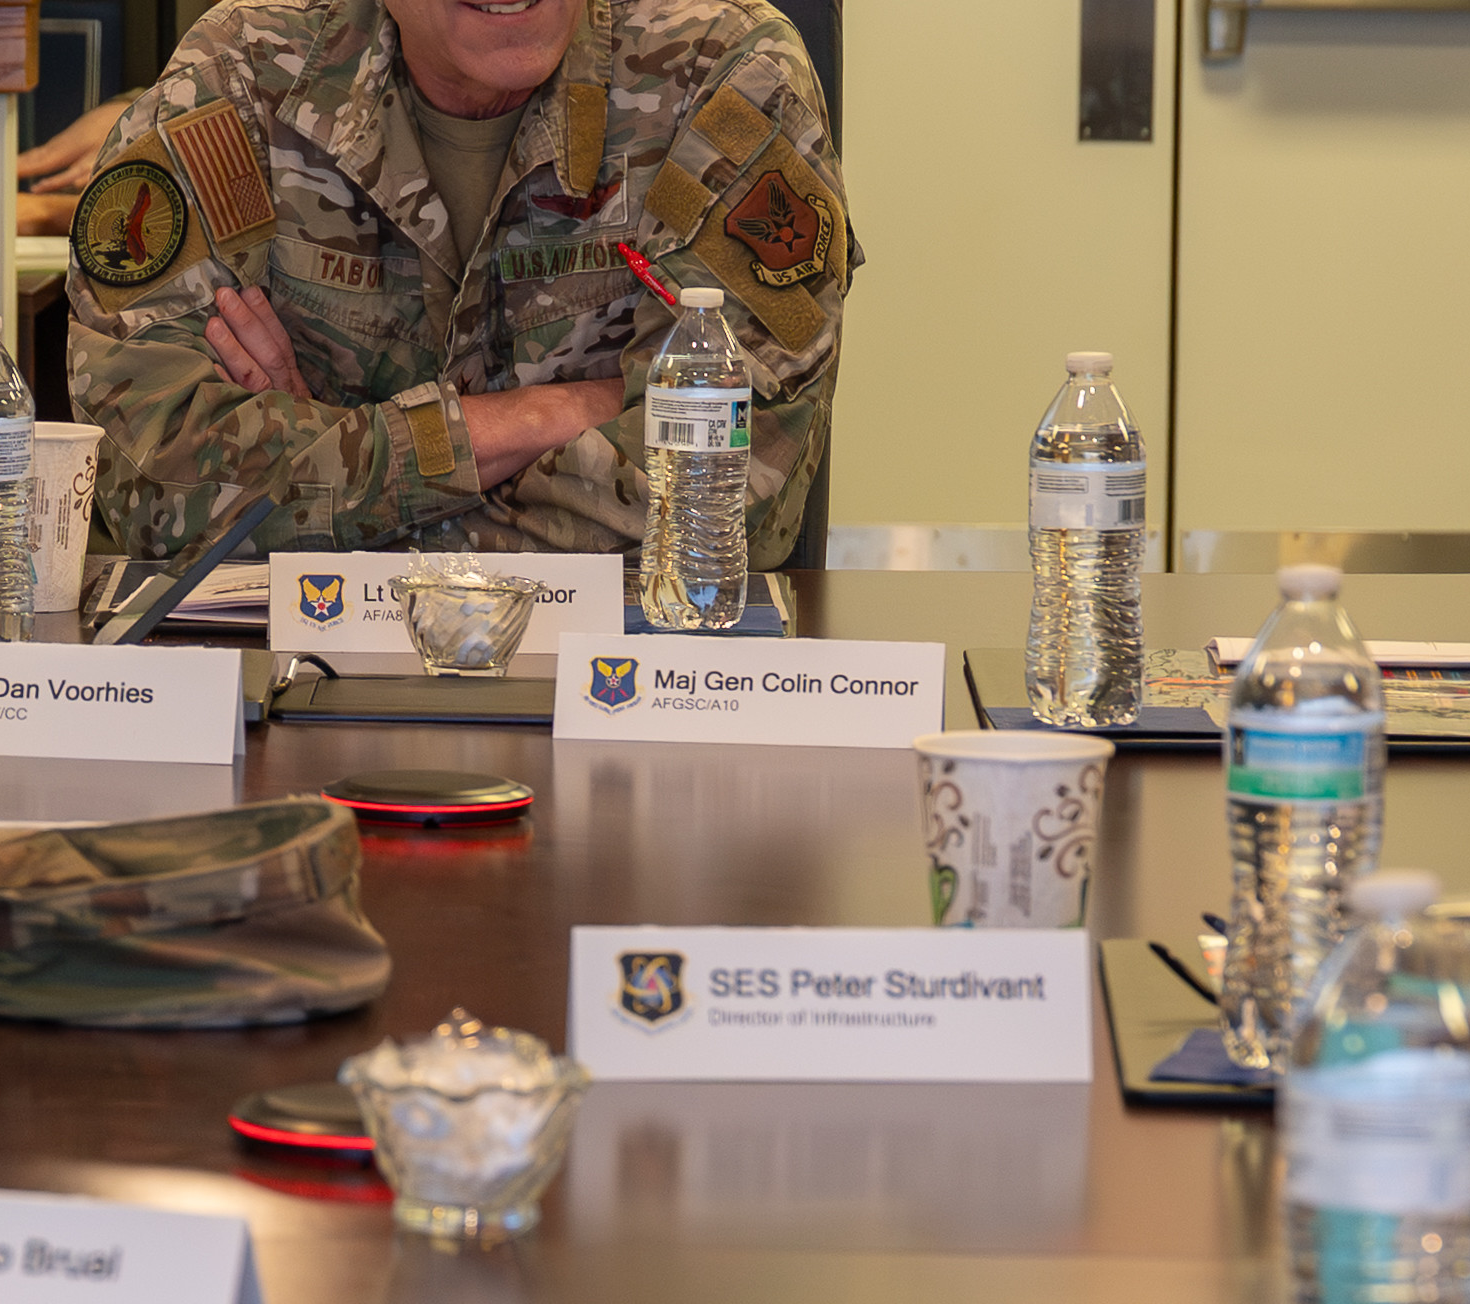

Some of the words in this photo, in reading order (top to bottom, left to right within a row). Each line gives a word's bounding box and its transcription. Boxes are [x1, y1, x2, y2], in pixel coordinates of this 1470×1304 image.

[772, 271, 792, 284] US
[794, 262, 818, 278] AIR
[815, 216, 831, 261] FORCE
[364, 583, 384, 602] Lt
[48, 680, 155, 704] Voorhies
[654, 670, 697, 695] Maj
[705, 671, 754, 693] Gen
[762, 672, 822, 694] Colin
[830, 674, 919, 696] Connor
[652, 698, 740, 712] AFGSC/A10
[710, 968, 779, 997] SES
[790, 969, 875, 997] Peter
[883, 970, 1046, 1000] Sturdivant
